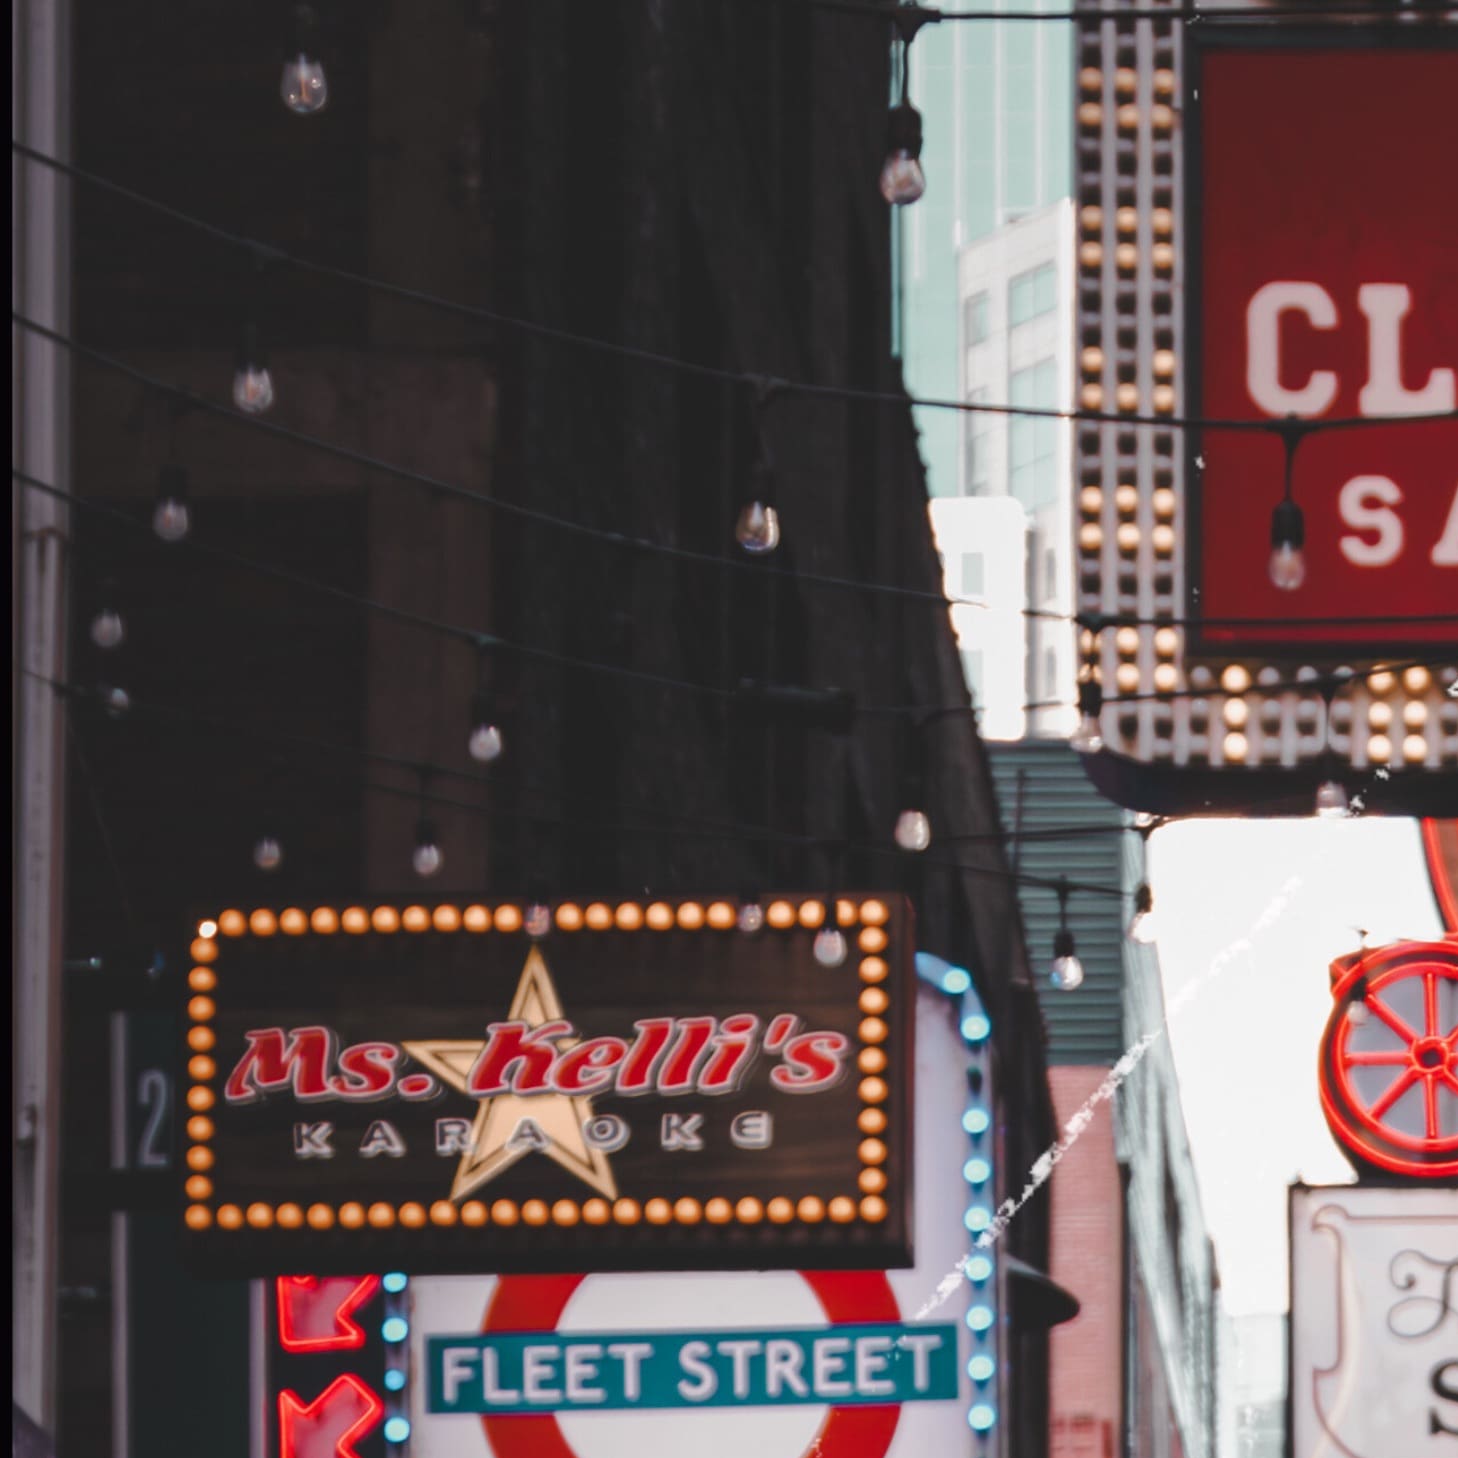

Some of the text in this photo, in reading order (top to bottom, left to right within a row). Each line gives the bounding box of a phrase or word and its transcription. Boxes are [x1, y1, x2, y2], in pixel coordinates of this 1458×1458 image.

[225, 1014, 848, 1099] Ms. Kelli's
[294, 1111, 774, 1158] KARAOKE
[441, 1334, 943, 1405] FLEET STREET
